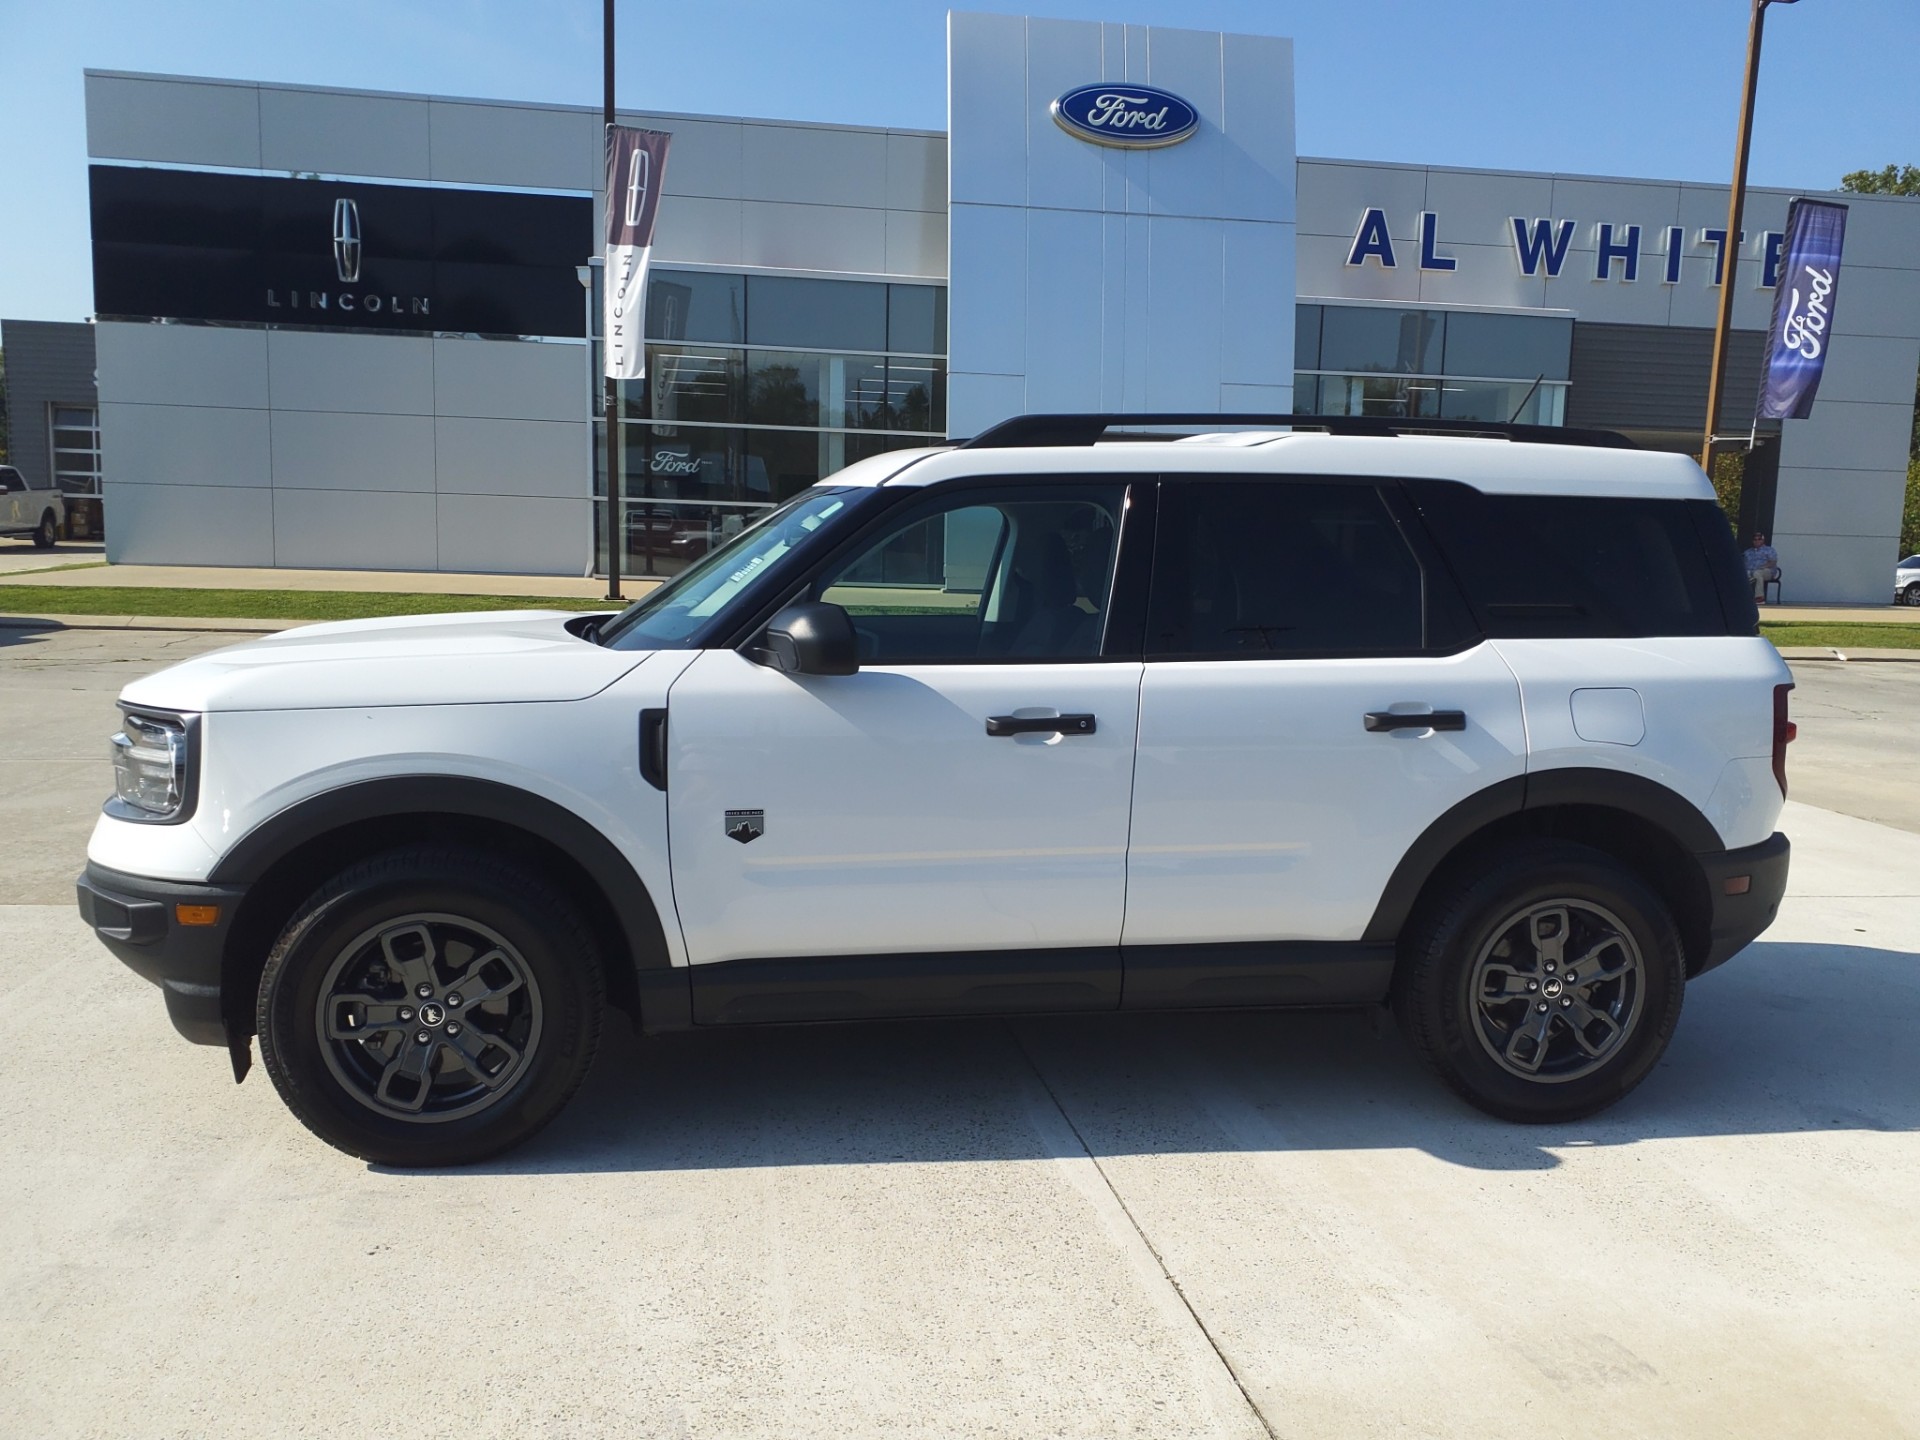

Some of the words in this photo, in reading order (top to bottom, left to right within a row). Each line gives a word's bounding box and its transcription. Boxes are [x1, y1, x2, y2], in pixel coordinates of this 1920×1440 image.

[1087, 94, 1169, 130] Ford
[1346, 207, 1458, 273] AL
[267, 288, 430, 315] LINCOLN
[613, 254, 633, 366] LINCOLN
[1783, 265, 1834, 360] Ford
[650, 450, 701, 474] Ford
